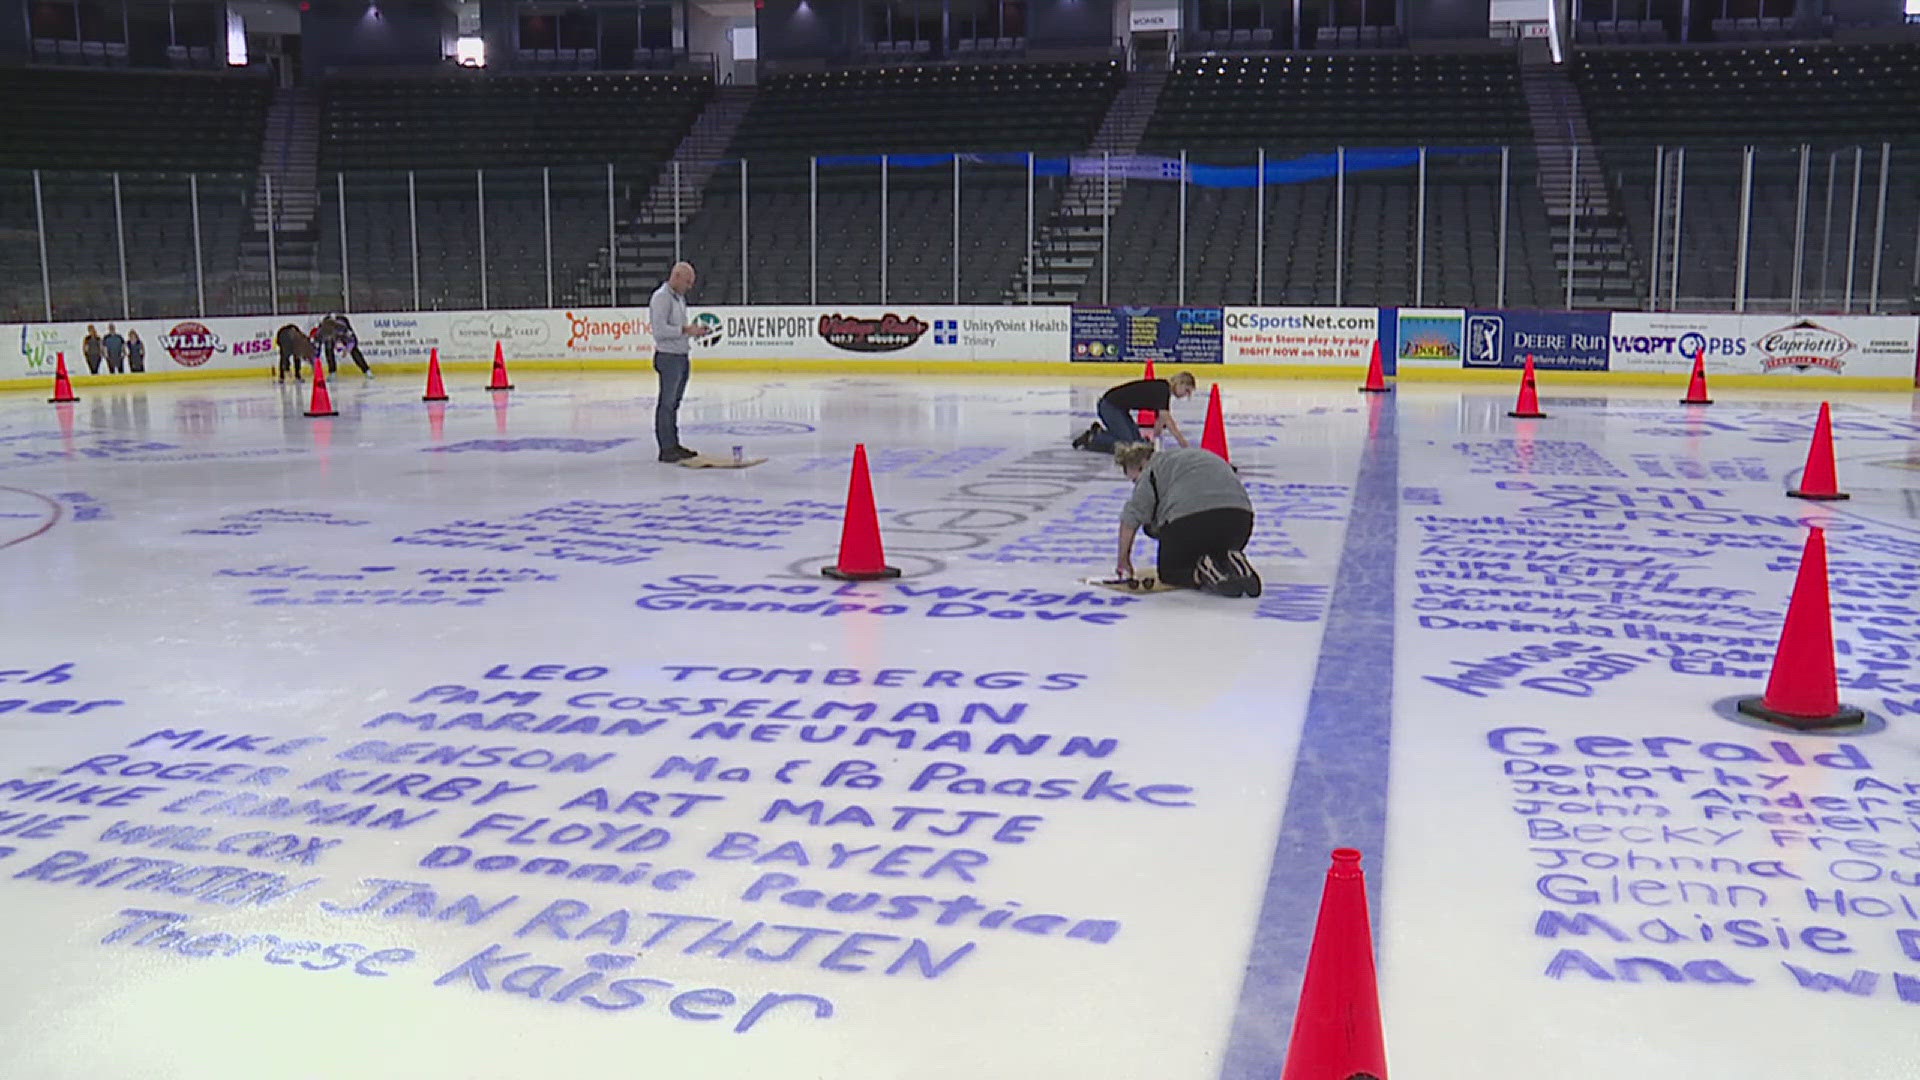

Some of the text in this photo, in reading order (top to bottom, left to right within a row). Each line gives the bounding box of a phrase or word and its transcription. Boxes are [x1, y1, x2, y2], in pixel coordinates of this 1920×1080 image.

[1132, 16, 1164, 25] WOMEN
[393, 319, 418, 328] Union
[727, 316, 816, 338] DAVENPORT
[963, 319, 1068, 334] UnityPoint Health
[1225, 312, 1375, 331] QCSportsNet.com
[232, 338, 272, 356] KISS
[963, 335, 997, 348] Trinity
[1229, 334, 1253, 343] Hear
[1255, 334, 1273, 343] live
[1275, 334, 1307, 344] Storm
[1239, 346, 1271, 357] RIGHT
[1272, 346, 1299, 357] NOW
[1301, 349, 1315, 357] on
[1343, 347, 1361, 358] FM
[1612, 335, 1747, 356] WQPT PBS
[1765, 334, 1845, 355] Capriotti's
[634, 593, 1128, 625] Grandpa Dave
[1418, 615, 1616, 640] Dorinda
[482, 663, 1089, 690] LEO TOMBERGS
[1520, 652, 1652, 698] Dean
[408, 684, 1029, 725] PAM COSSELMAN
[361, 711, 1119, 758] MARIAN NEUMANN
[1486, 726, 1874, 771] Gerald
[125, 729, 329, 756] MIKE
[335, 738, 618, 774] BENSON
[650, 755, 752, 784] Ma
[819, 759, 885, 791] Pa
[1503, 758, 1791, 791] Dorothy
[59, 753, 1045, 845] ROGER KIRBY ART MATJE
[1512, 778, 1660, 799] John
[1511, 799, 1672, 818] John
[0, 778, 167, 807] MIKE
[459, 812, 671, 854] FLOYD
[706, 831, 990, 884] BAYER
[98, 818, 345, 867] WILCOX
[1528, 847, 1805, 880] Johnna
[1535, 873, 1768, 908] Glenn
[319, 877, 521, 927] JAN
[513, 897, 978, 981] RATHJEN
[1534, 909, 1857, 955] Maisie
[1543, 948, 1757, 986] Ana
[432, 942, 835, 1035] Kaiser
